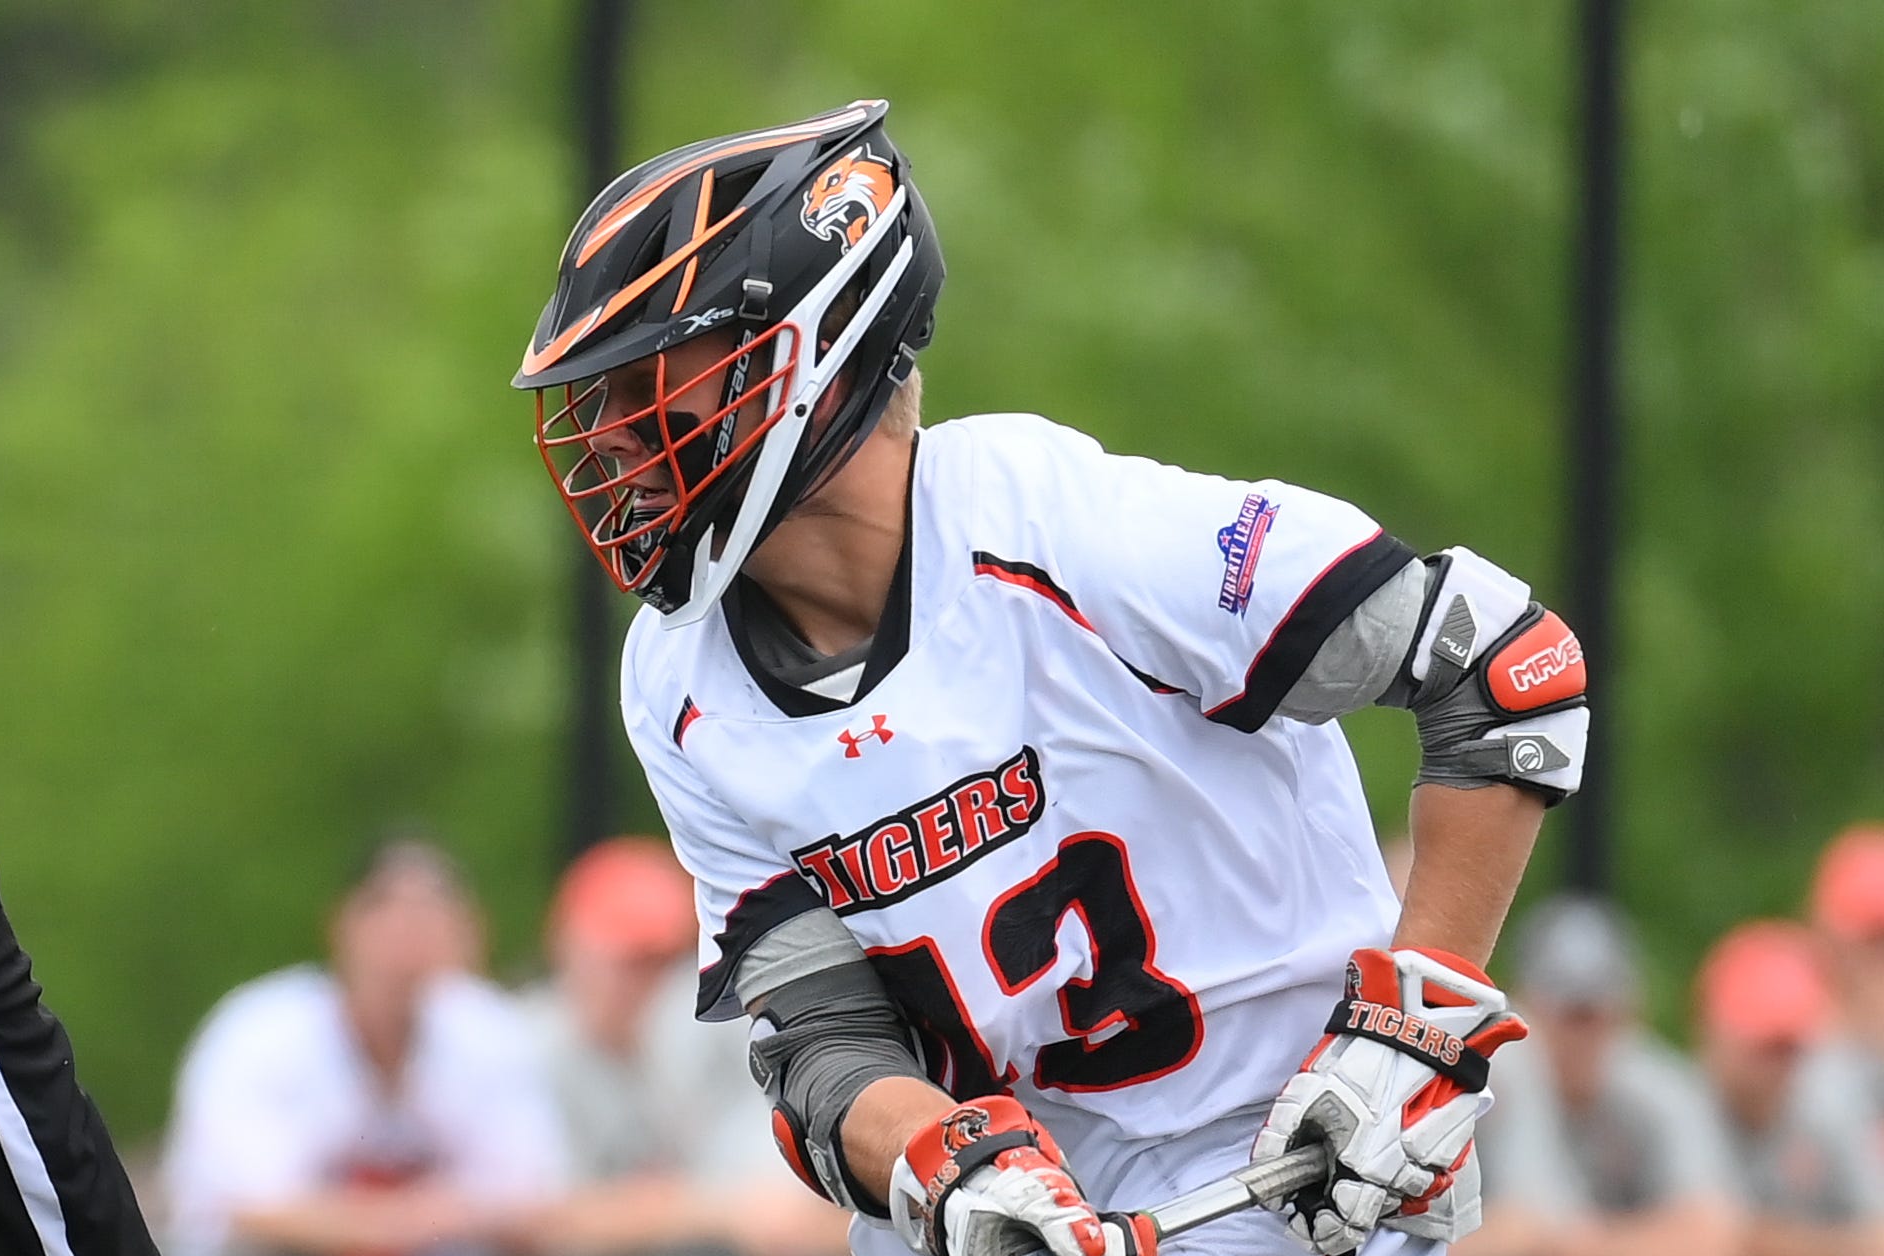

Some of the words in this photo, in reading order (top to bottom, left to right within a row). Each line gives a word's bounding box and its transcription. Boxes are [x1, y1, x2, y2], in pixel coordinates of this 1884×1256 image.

[1220, 543, 1245, 610] LIBERTY
[1234, 493, 1263, 544] LEAGUE
[796, 748, 1042, 912] TIGERS
[1347, 1000, 1465, 1066] TIGERS
